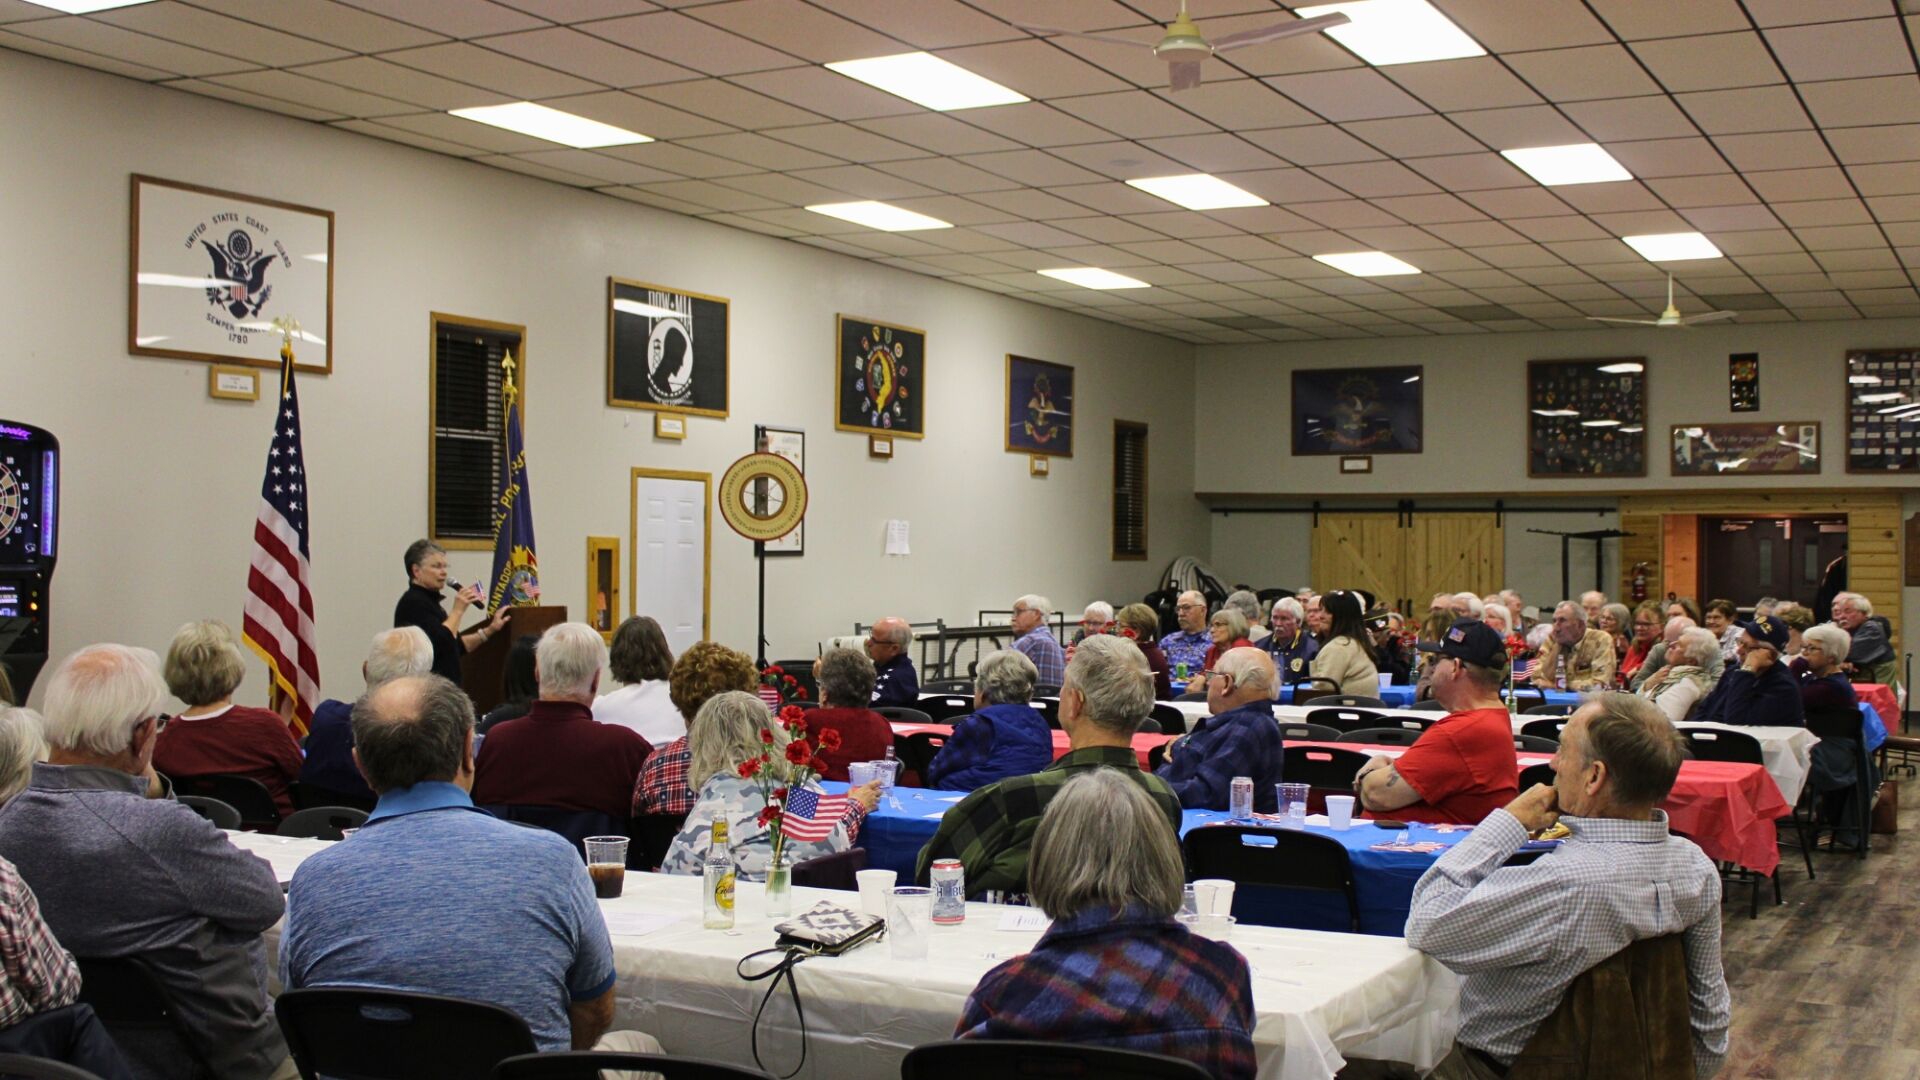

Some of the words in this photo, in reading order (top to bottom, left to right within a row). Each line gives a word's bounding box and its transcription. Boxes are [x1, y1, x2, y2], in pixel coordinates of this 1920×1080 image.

[185, 222, 206, 249] UNITED
[212, 213, 238, 224] STATES
[246, 216, 268, 234] COAST
[274, 240, 291, 269] GUARD
[206, 312, 235, 331] SEMPER
[228, 332, 248, 344] 1790
[21, 482, 29, 491] 13
[21, 512, 28, 520] 10
[14, 526, 22, 534] 15
